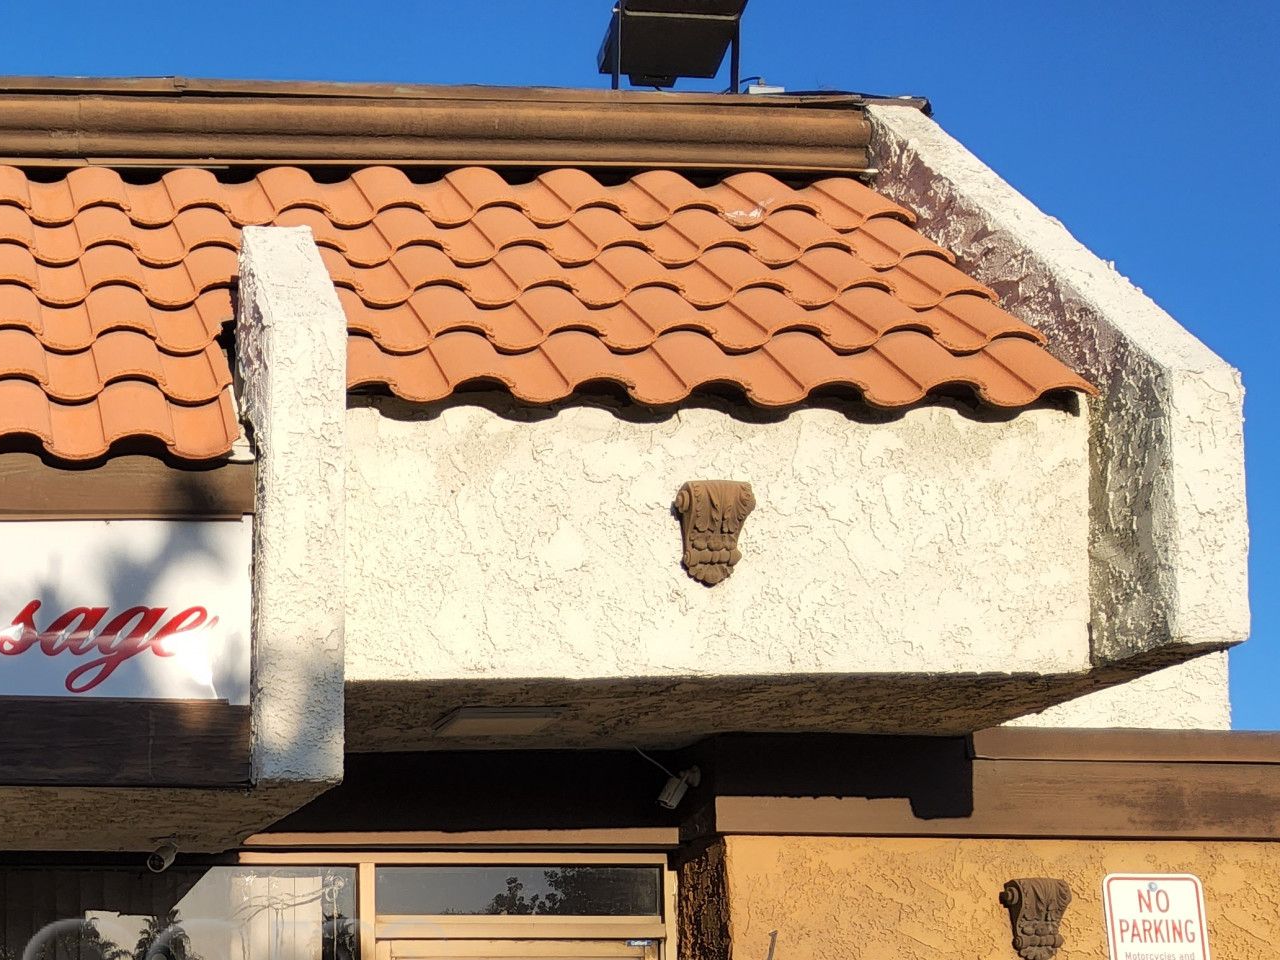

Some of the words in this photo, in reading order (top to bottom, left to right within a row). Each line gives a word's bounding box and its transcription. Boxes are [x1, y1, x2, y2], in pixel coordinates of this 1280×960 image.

[1137, 889, 1170, 913] NO
[1119, 918, 1196, 943] PARKING
[1179, 951, 1195, 960] and
